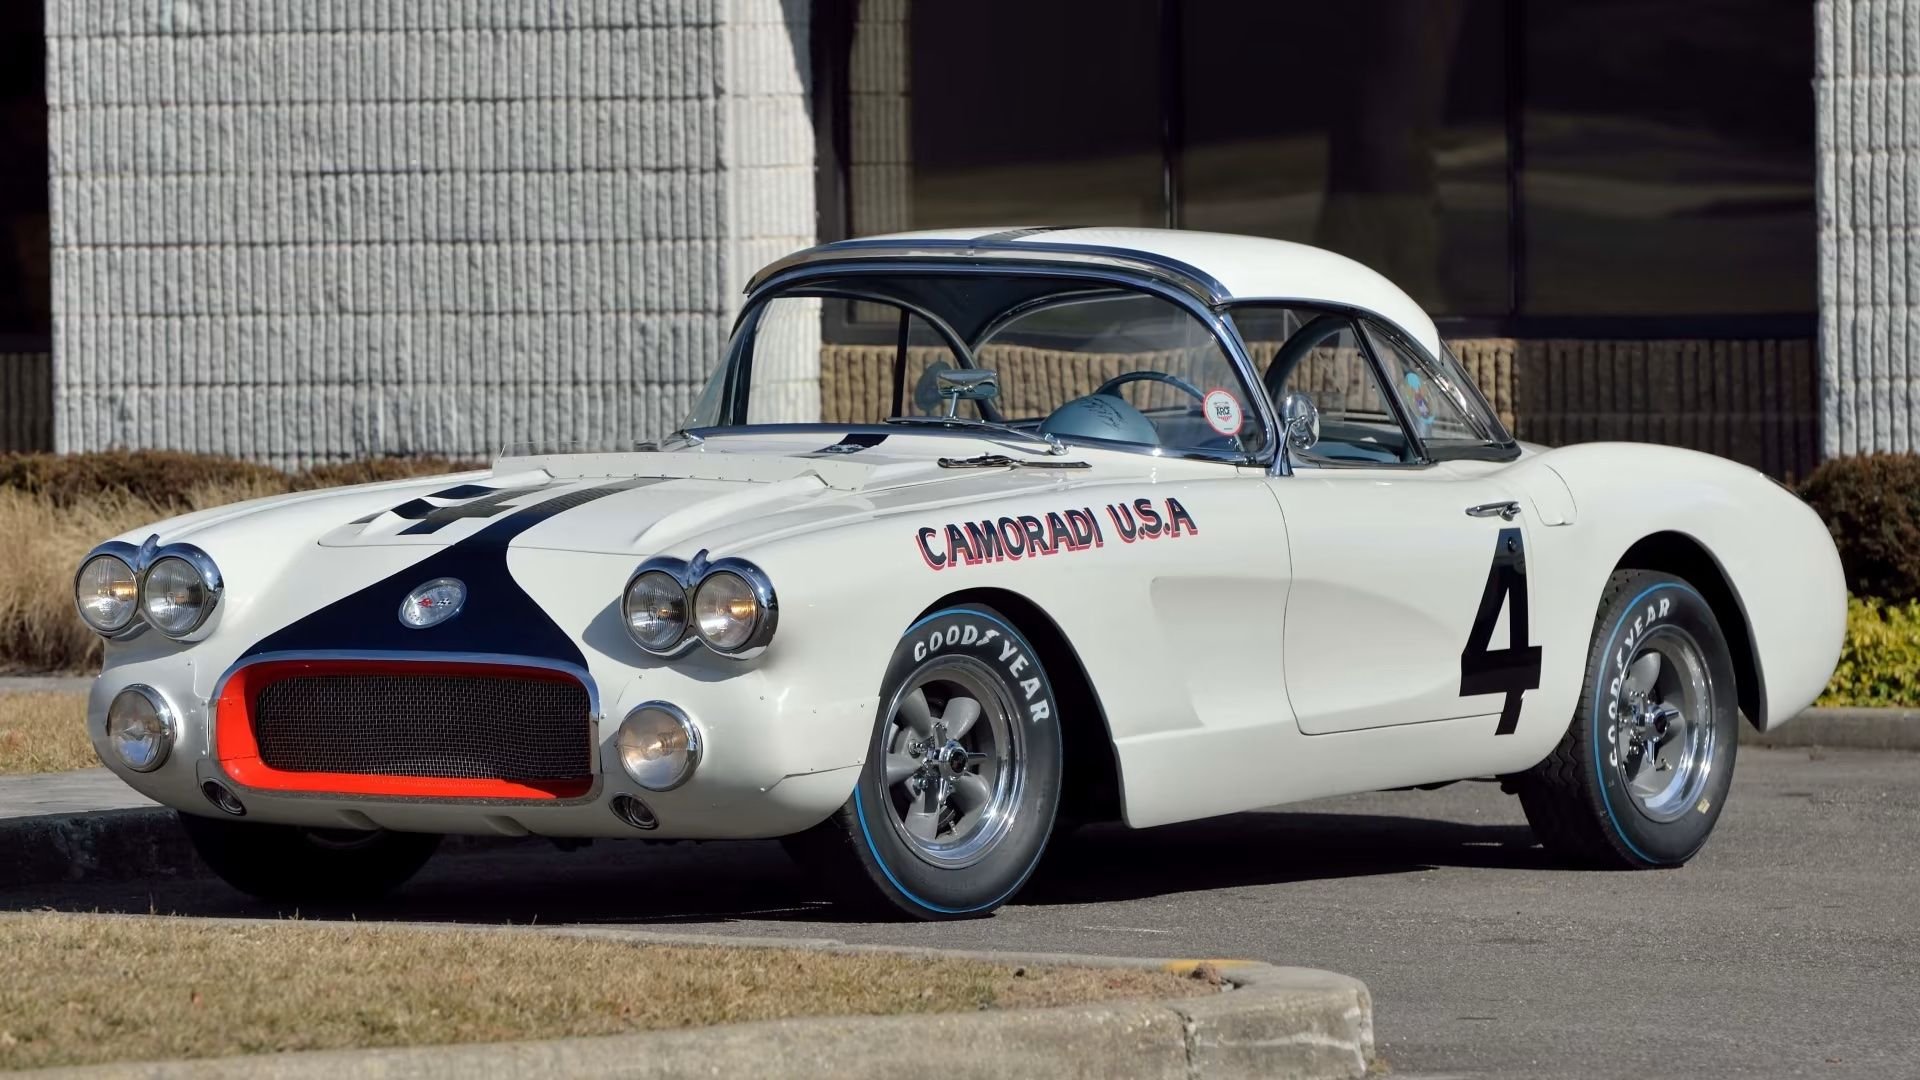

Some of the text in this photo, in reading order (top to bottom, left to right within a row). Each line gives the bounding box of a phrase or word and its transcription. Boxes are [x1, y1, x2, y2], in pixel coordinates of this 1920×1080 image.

[916, 497, 1198, 571] CAMORADI U.S.A
[1460, 528, 1542, 735] 4
